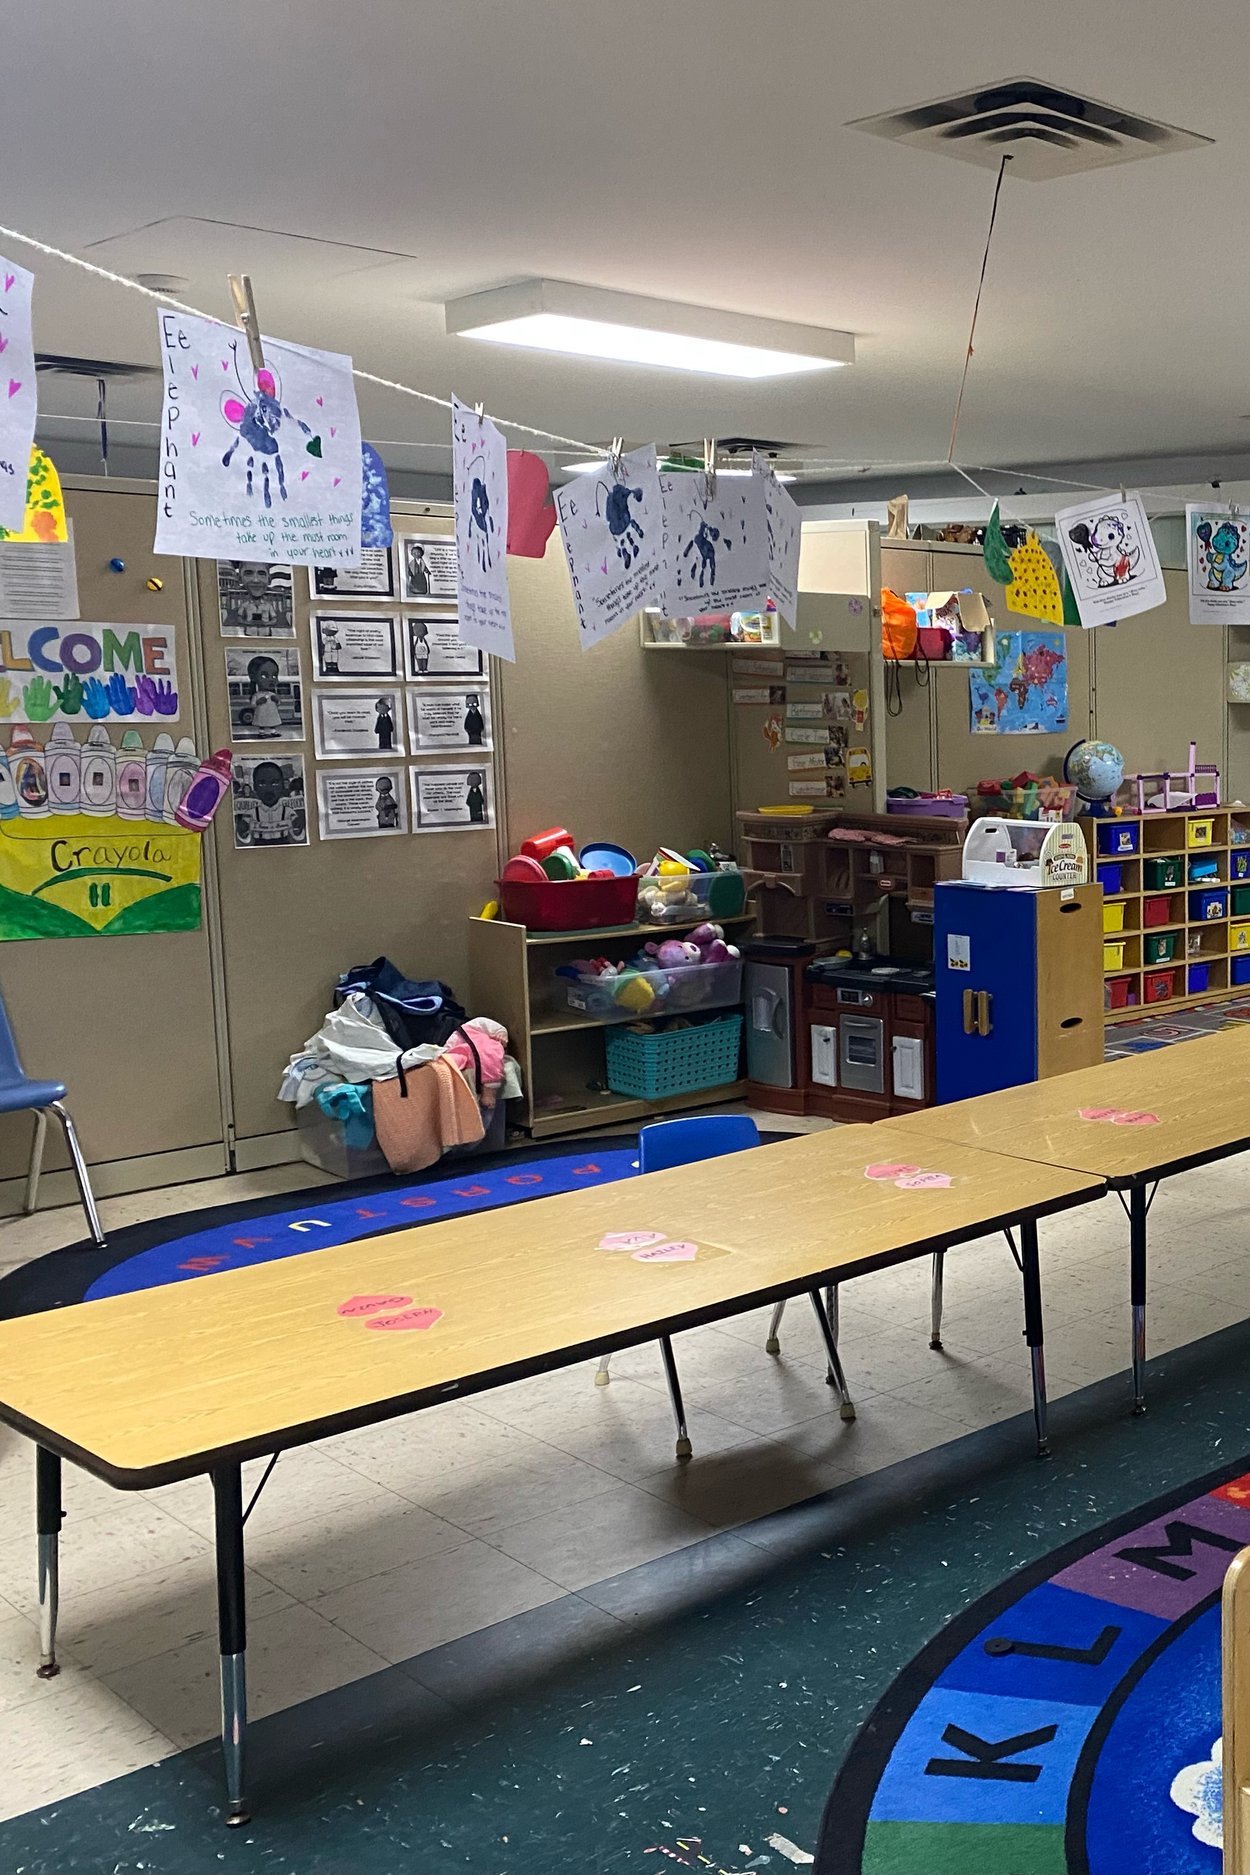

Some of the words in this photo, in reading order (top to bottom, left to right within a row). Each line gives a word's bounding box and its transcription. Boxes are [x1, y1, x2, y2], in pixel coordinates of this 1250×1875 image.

[190, 513, 252, 528] Sometimes
[258, 513, 276, 528] the
[283, 515, 324, 529] smallest
[328, 512, 354, 528] things
[236, 532, 257, 544] take
[262, 533, 277, 545] up
[281, 532, 297, 543] the
[326, 533, 348, 543] room
[268, 549, 279, 558] in
[286, 547, 309, 560] your
[313, 546, 339, 559] heart
[0, 627, 170, 675] LCOME
[51, 840, 172, 872] Crayola
[1048, 863, 1059, 875] Ice
[1060, 860, 1082, 872] Cream
[1053, 872, 1076, 880] COUNTER
[288, 1219, 332, 1233] U
[341, 1296, 406, 1315] GAVIN
[924, 1723, 1056, 1783] K
[990, 1625, 1122, 1666] L
[1112, 1520, 1243, 1581] M
